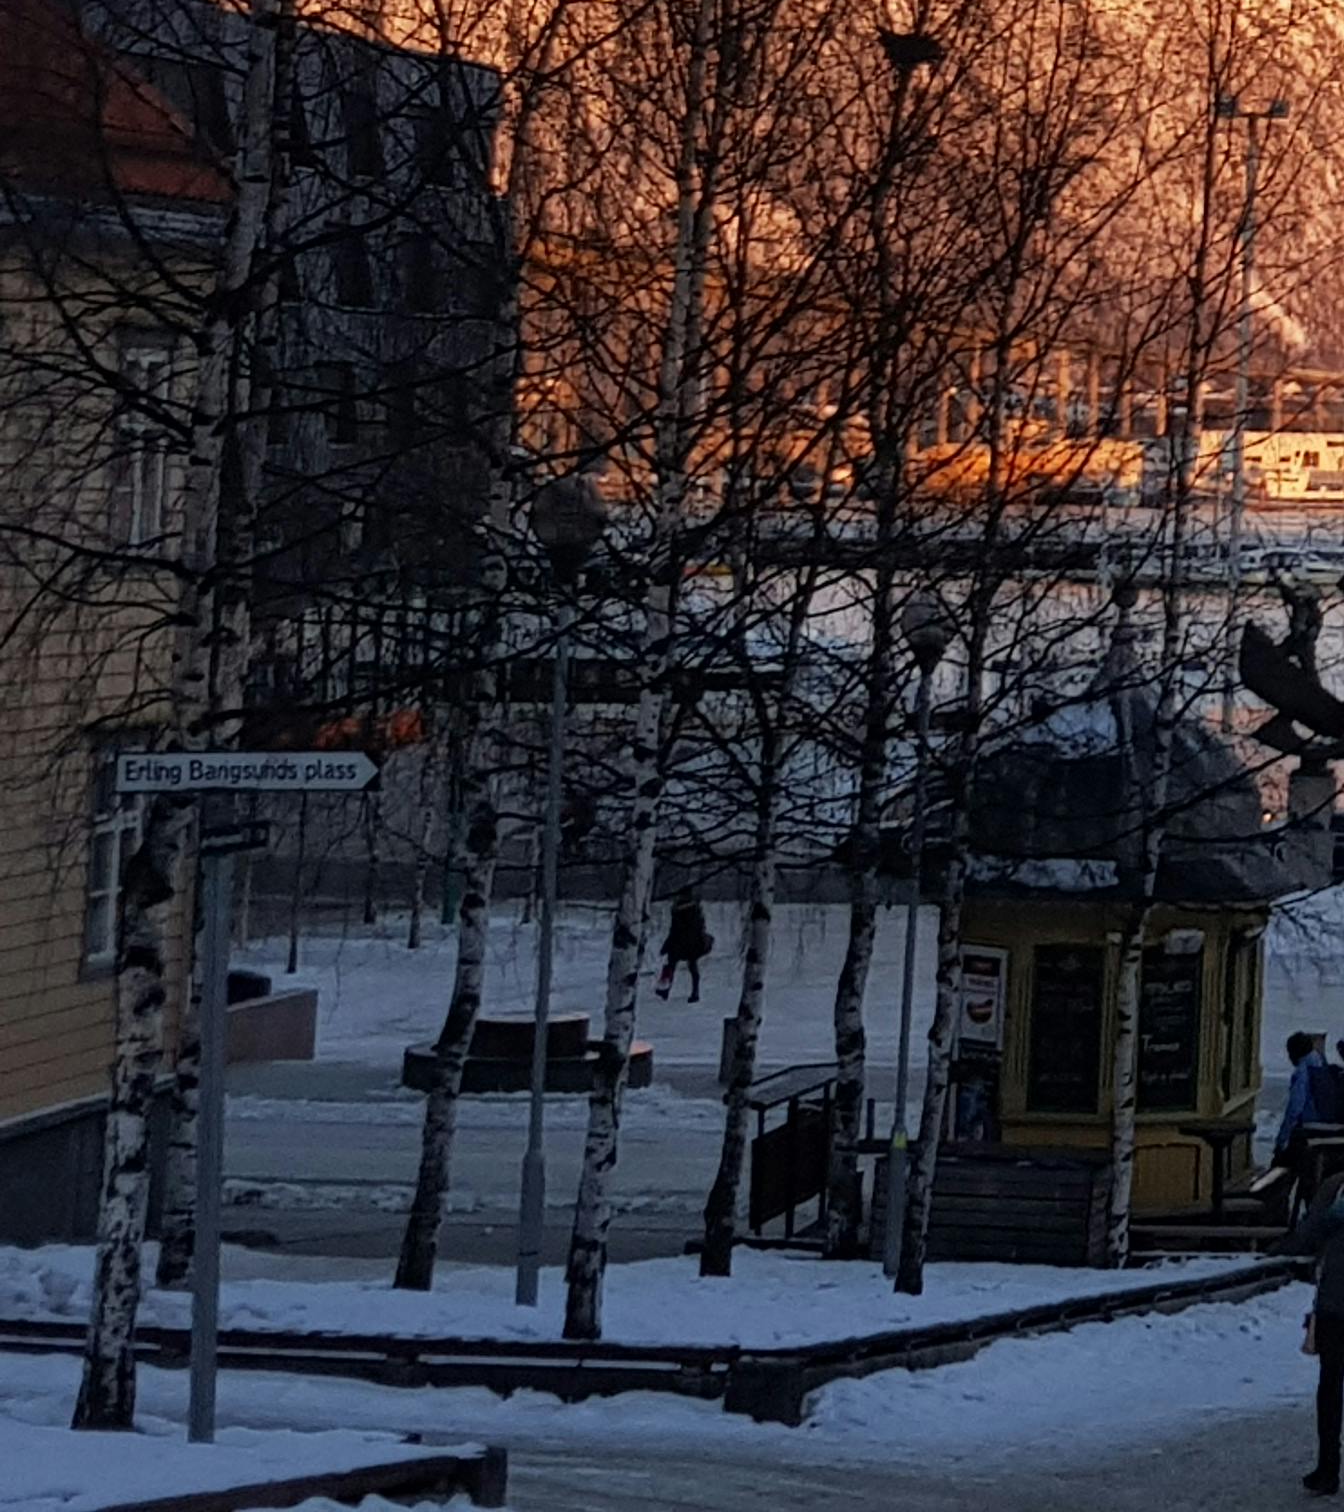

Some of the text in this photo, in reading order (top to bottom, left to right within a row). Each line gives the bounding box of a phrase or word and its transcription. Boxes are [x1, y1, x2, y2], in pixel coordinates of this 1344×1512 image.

[125, 759, 357, 785] Erling Bangsunds plass
